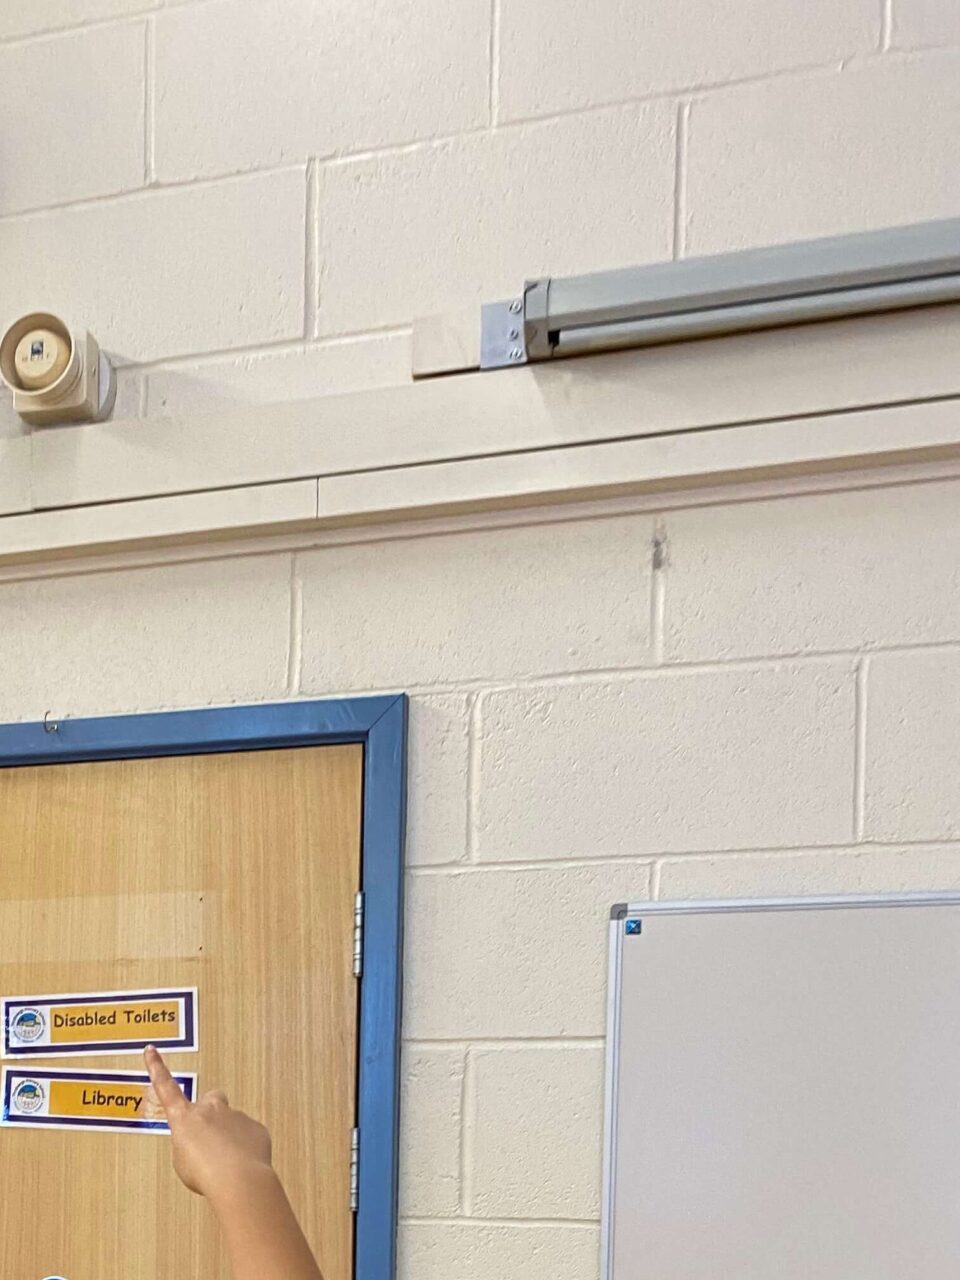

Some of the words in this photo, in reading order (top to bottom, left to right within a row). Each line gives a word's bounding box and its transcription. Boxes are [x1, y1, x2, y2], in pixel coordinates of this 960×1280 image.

[53, 1011, 116, 1028] Disabled
[124, 1008, 176, 1024] Toilets
[82, 1090, 143, 1111] Library
